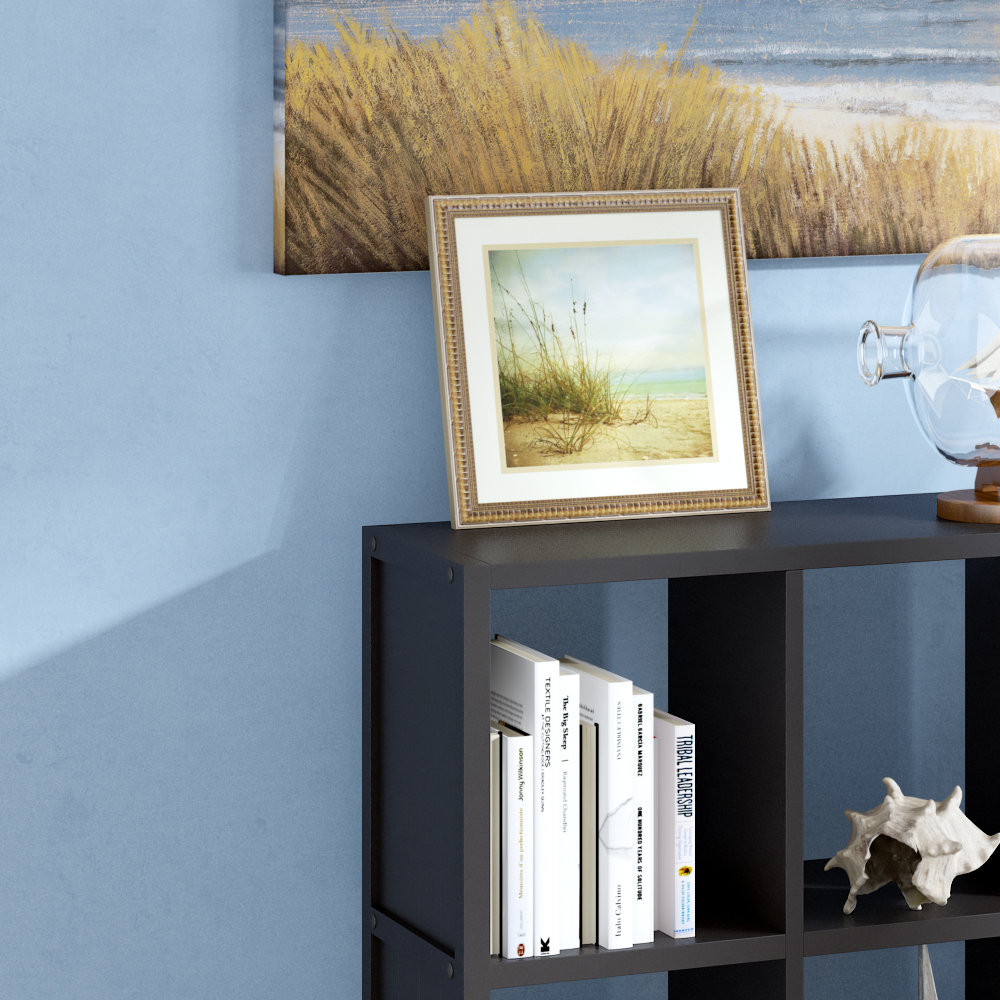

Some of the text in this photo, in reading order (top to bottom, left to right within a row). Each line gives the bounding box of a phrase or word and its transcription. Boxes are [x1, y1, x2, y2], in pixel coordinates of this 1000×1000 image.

[561, 712, 569, 727] Big
[676, 735, 693, 766] TRIBAL
[677, 767, 693, 818] LEADERSHIP
